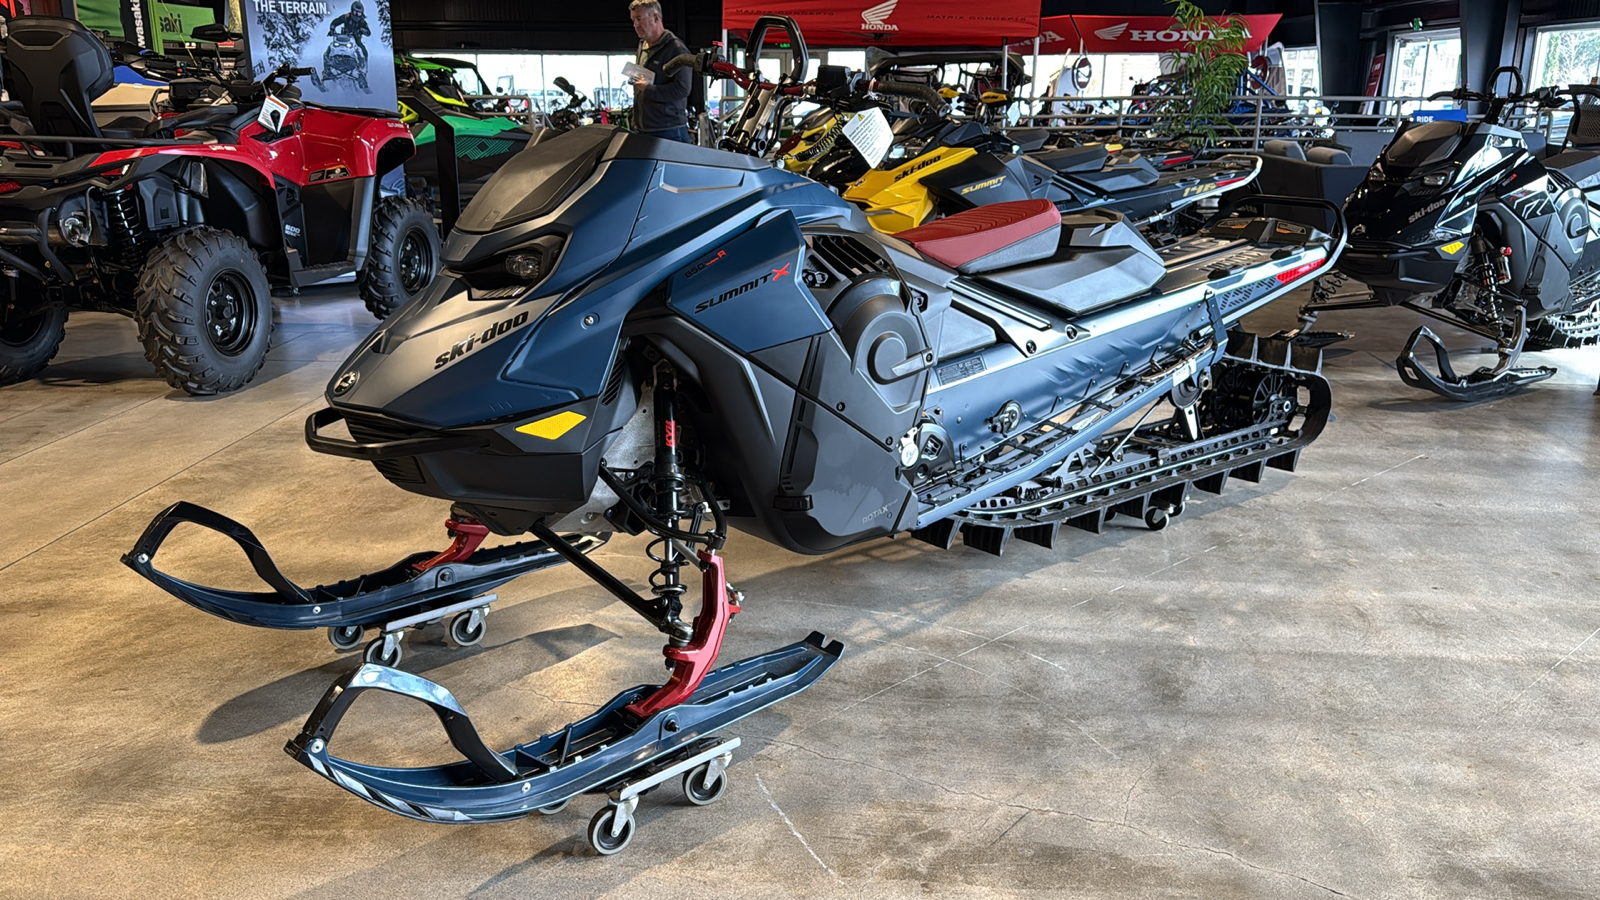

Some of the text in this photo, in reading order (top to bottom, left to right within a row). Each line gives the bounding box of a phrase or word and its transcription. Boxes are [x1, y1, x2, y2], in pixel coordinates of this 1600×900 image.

[253, 0, 331, 15] THE TERRAIN.
[130, 0, 147, 49] wasaki
[860, 23, 899, 31] HONDA
[894, 155, 941, 183] ski-doo
[961, 175, 1007, 195] SUMMIT
[1408, 199, 1446, 223] ski-doo
[684, 263, 706, 278] 850
[434, 311, 529, 370] ski-doo
[862, 504, 888, 524] ROTAX
